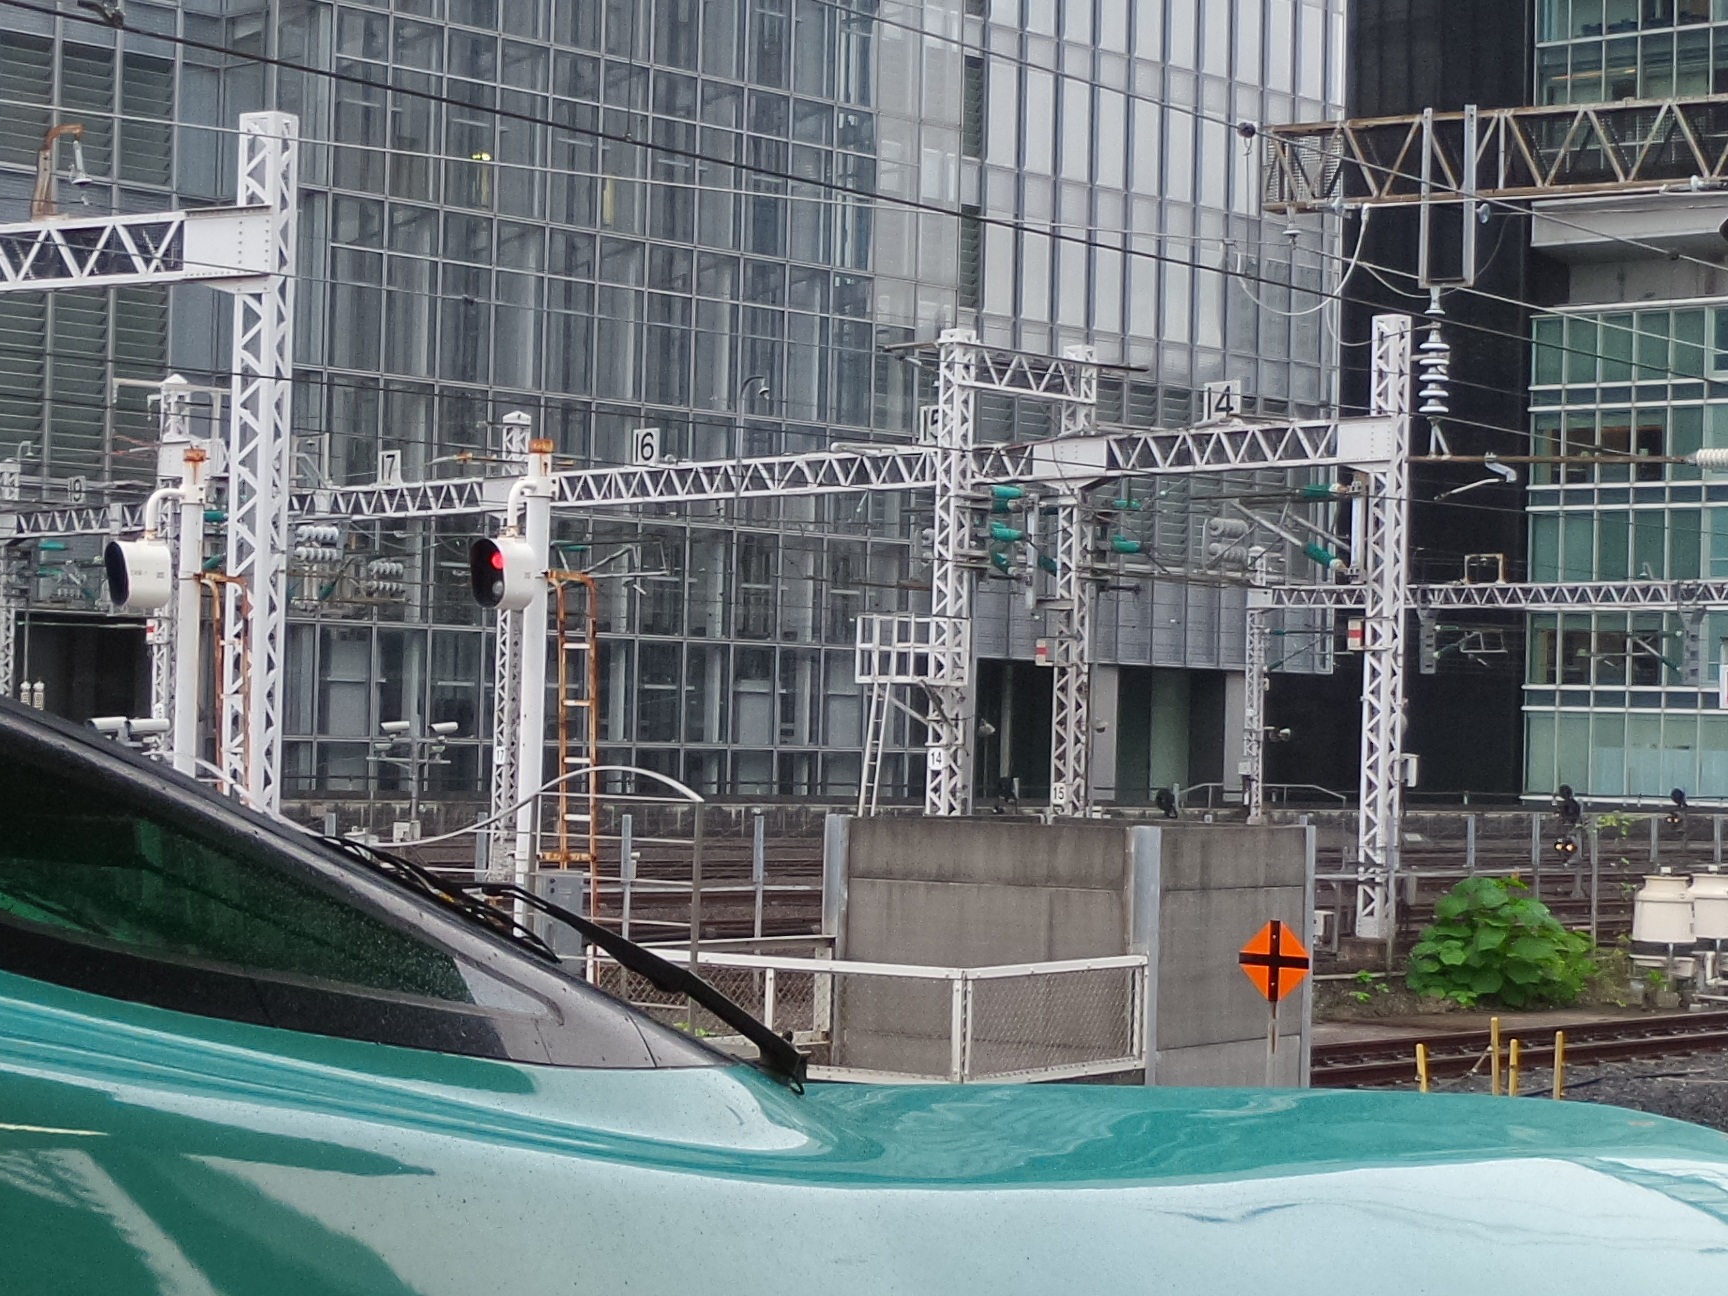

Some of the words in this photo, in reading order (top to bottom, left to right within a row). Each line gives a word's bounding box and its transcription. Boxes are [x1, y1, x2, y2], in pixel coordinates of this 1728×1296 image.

[1206, 385, 1234, 422] 14
[635, 431, 655, 462] 16
[382, 454, 397, 478] 17
[930, 751, 942, 765] 14
[1053, 786, 1065, 800] 15
